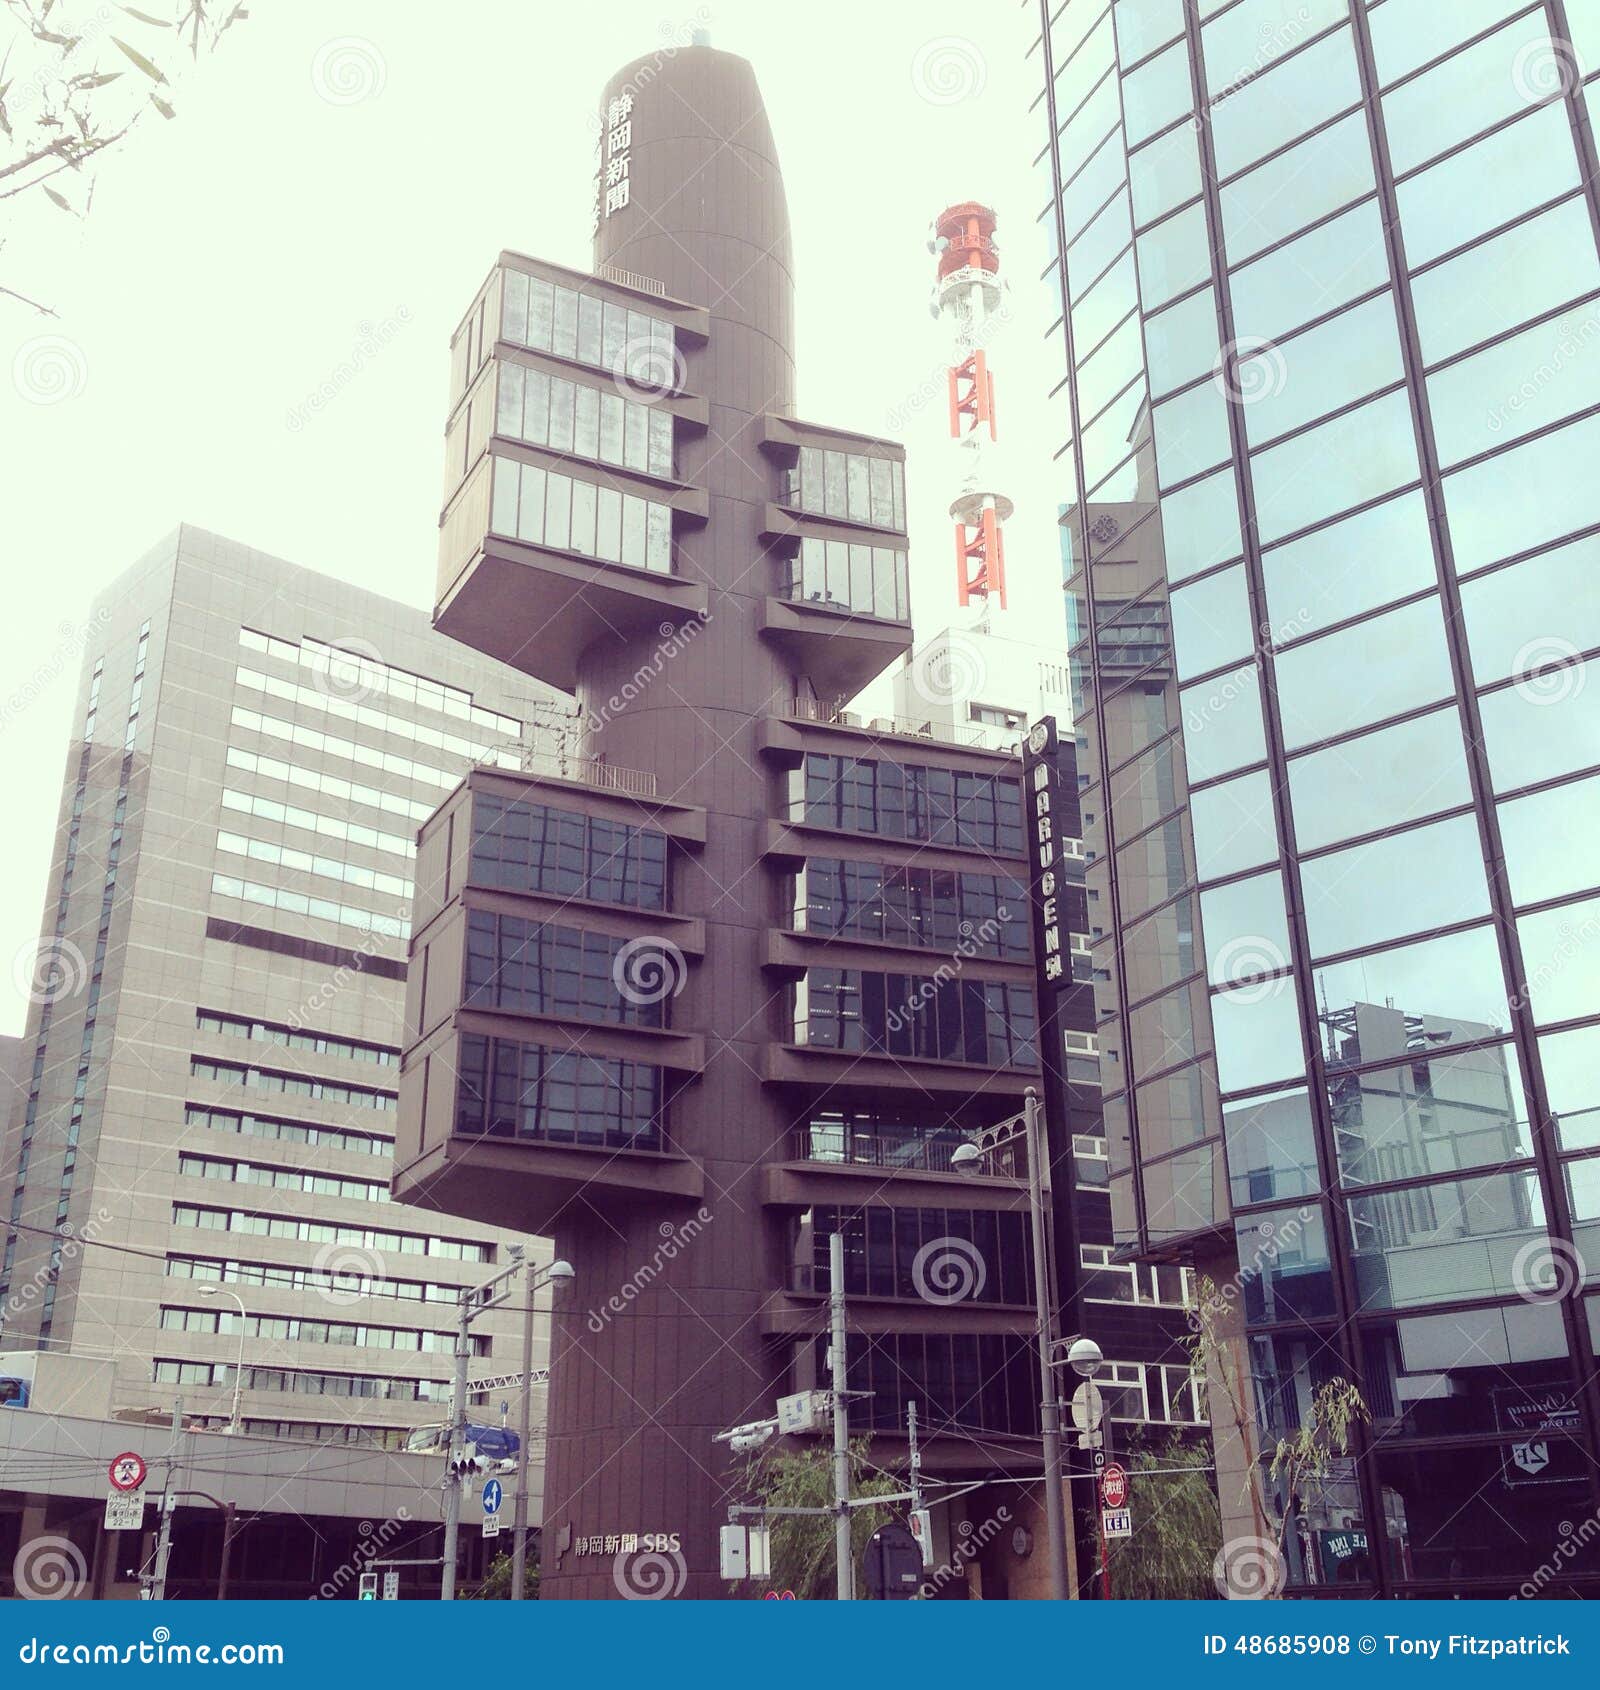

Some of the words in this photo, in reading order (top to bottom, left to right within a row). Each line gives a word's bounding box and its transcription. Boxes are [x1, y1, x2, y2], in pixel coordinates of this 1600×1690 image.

[606, 93, 634, 218] 静岡新聞
[1034, 763, 1060, 954] MARUGEN
[575, 1534, 638, 1556] 静岡新聞
[643, 1533, 681, 1553] SBS
